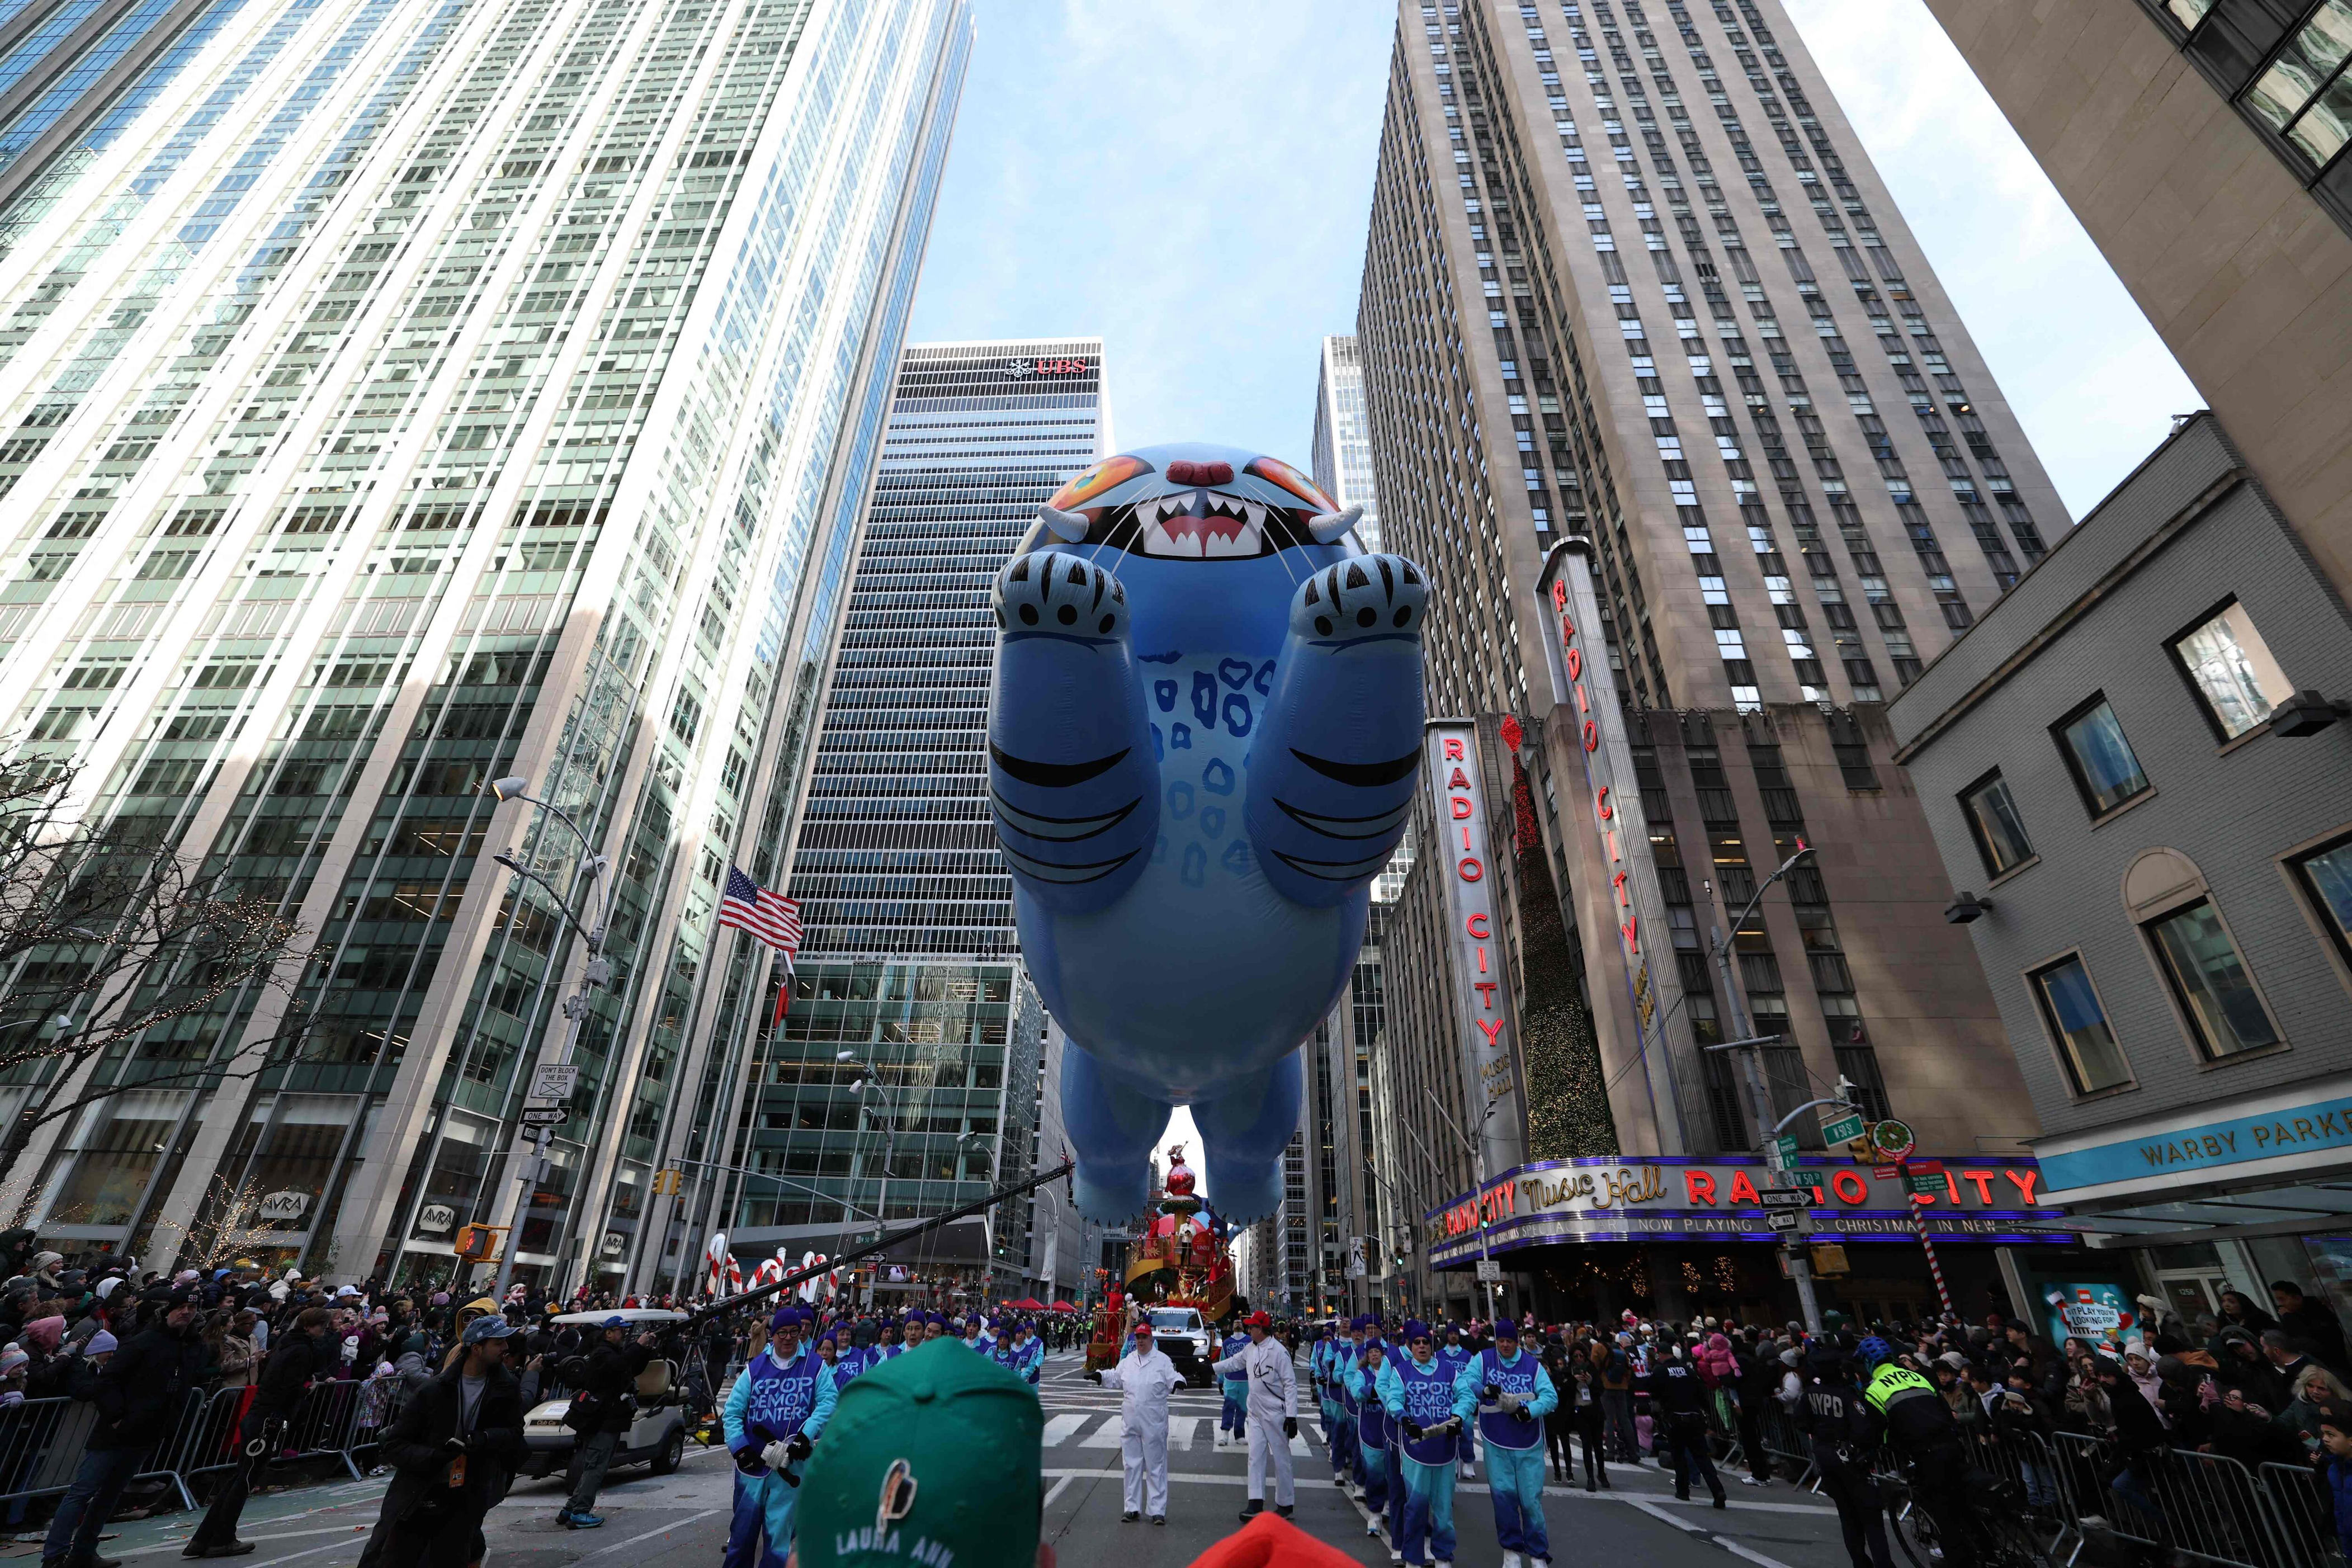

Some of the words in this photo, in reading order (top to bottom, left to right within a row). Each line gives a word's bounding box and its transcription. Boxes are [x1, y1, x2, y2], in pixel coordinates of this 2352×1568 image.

[1036, 359, 1087, 375] UBS
[1552, 579, 1597, 752] RADIO
[1597, 786, 1638, 954] CITY
[1444, 738, 1484, 882] RADIO
[1466, 913, 1504, 1046] CITY
[1480, 1054, 1510, 1084] MUSIC
[1487, 1075, 1513, 1100] HALL
[1838, 1125, 1847, 1137] 50
[2140, 1131, 2236, 1167] WARBY
[1786, 1156, 1790, 1167] 6
[1685, 1170, 1868, 1205] RAIO
[1912, 1170, 2037, 1205] ITY
[1803, 1174, 1814, 1184] 50
[1520, 1174, 1595, 1212] Music
[1591, 1165, 1668, 1209] Hall
[1791, 1194, 1807, 1203] WAY
[1446, 1200, 1478, 1236] RADIO
[1638, 1218, 1674, 1231] NOW
[1684, 1218, 1753, 1231] PLAYING
[1782, 1216, 1793, 1225] WAY
[1835, 1219, 1917, 1231] CHRISTMA
[1937, 1220, 1953, 1231] IN
[1963, 1220, 1995, 1232] NEW
[2076, 1306, 2096, 1316] PLAY
[2072, 1316, 2103, 1326] LOOKING
[1486, 1367, 1532, 1385] K-POP
[1879, 1370, 1921, 1388] NYPD
[752, 1377, 814, 1395] K-POP
[749, 1388, 813, 1409] DEMON
[1808, 1392, 1844, 1418] NYPD
[747, 1406, 809, 1424] HUNTERS
[1409, 1406, 1452, 1420] HUNTER
[836, 1526, 900, 1556] LAURA
